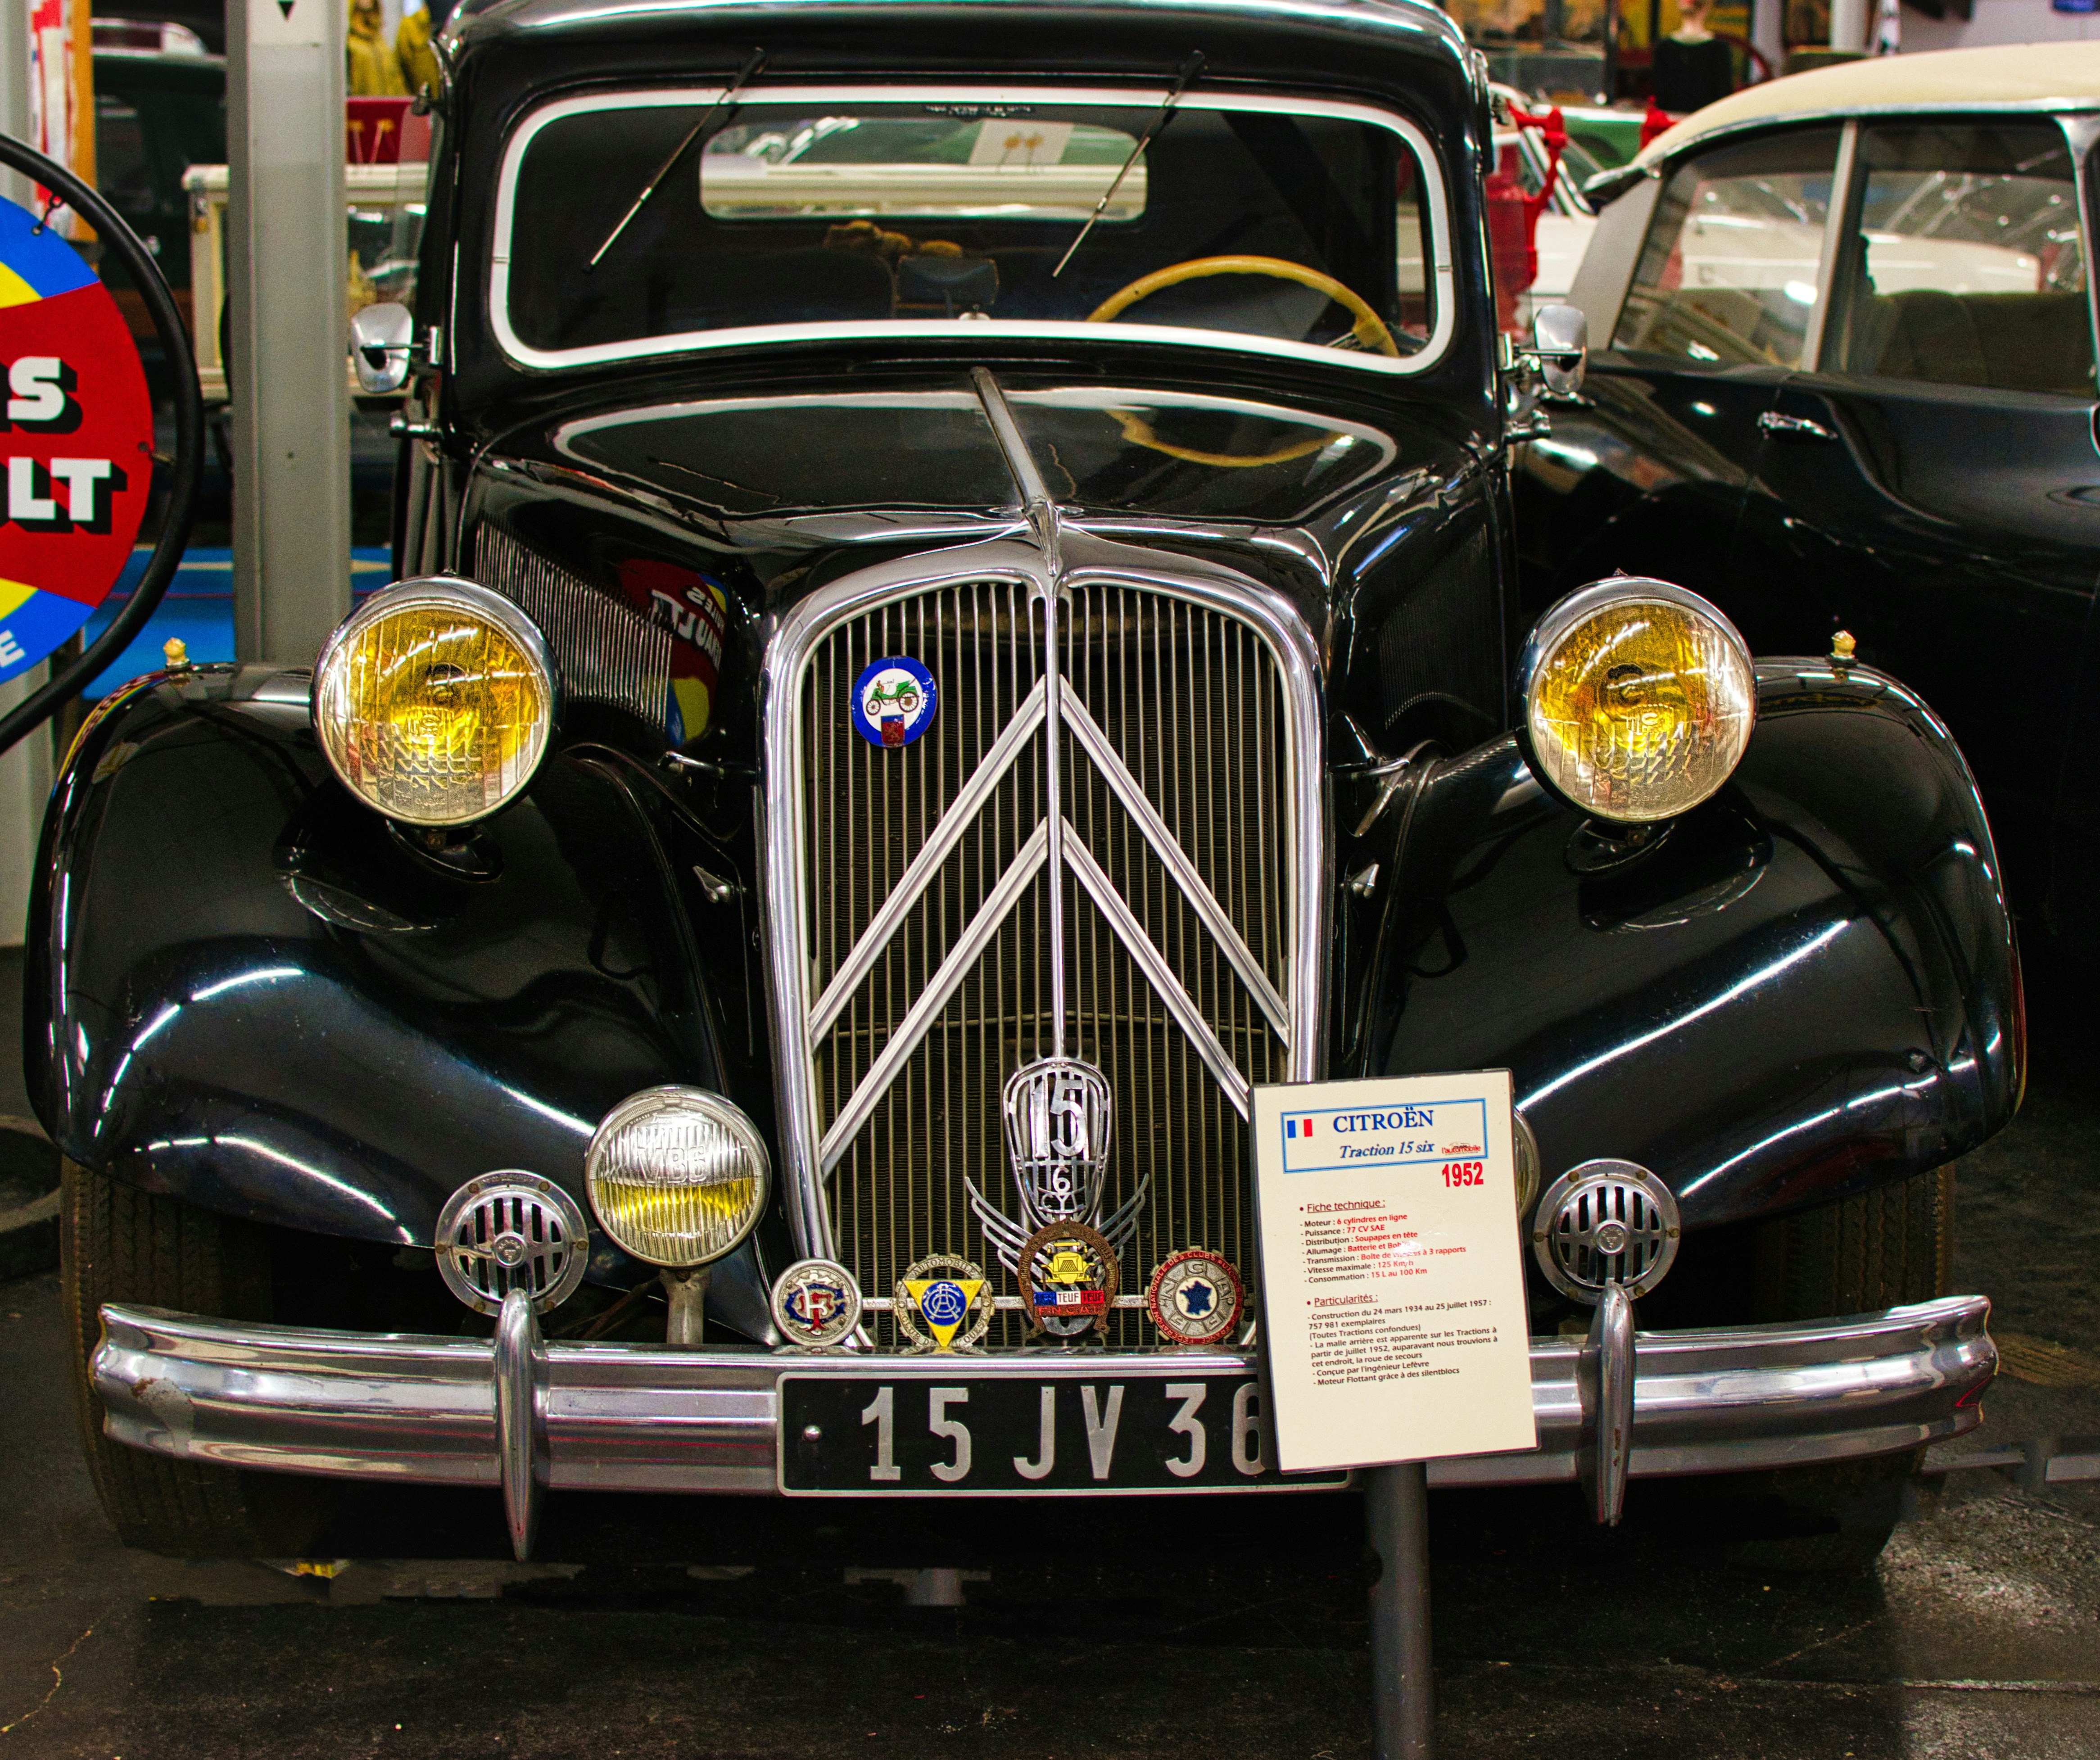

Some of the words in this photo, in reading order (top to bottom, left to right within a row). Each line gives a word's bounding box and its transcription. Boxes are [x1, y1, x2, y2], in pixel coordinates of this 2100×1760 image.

[1032, 1079, 1086, 1158] 15
[1333, 1107, 1435, 1133] CITROËN
[1339, 1144, 1394, 1159] Traction
[1398, 1141, 1414, 1154] 15
[1417, 1140, 1435, 1153] six
[1052, 1167, 1070, 1193] 6
[1441, 1162, 1484, 1188] 1952
[1307, 1203, 1332, 1213] Fiche
[1334, 1199, 1380, 1210] technique
[1343, 1217, 1377, 1226] cylindres
[1305, 1238, 1349, 1246] Distribution
[1355, 1235, 1391, 1243] Soupapes
[1187, 1251, 1216, 1261] CLUBS
[1305, 1248, 1342, 1256] Allumage
[1347, 1244, 1377, 1252] Batterie
[1306, 1255, 1355, 1265] Transmission
[1435, 1246, 1467, 1255] rapports
[912, 1258, 976, 1277] AUTOMOBILE
[1335, 1263, 1372, 1271] maximale
[1308, 1274, 1365, 1284] Consommation
[1057, 1293, 1079, 1303] TEUF
[1082, 1292, 1103, 1302] TEUF
[1314, 1294, 1373, 1306] Particularités
[1311, 1311, 1360, 1320] Construction
[1446, 1302, 1468, 1311] juillet
[1341, 1318, 1386, 1327] exemplaires
[1309, 1332, 1337, 1341] (Toutes
[1375, 1324, 1421, 1333] confondues)
[1389, 1334, 1428, 1343] apparente
[1311, 1351, 1332, 1359] partir
[1344, 1348, 1367, 1357] juillet
[1392, 1342, 1435, 1352] auparavant
[1325, 1358, 1354, 1366] endroit,
[1361, 1364, 1401, 1373] l'ingénieur
[1421, 1368, 1460, 1376] silentblocs
[861, 1386, 972, 1483] 15
[1013, 1385, 1125, 1480] JV
[1165, 1382, 1266, 1478] 36
